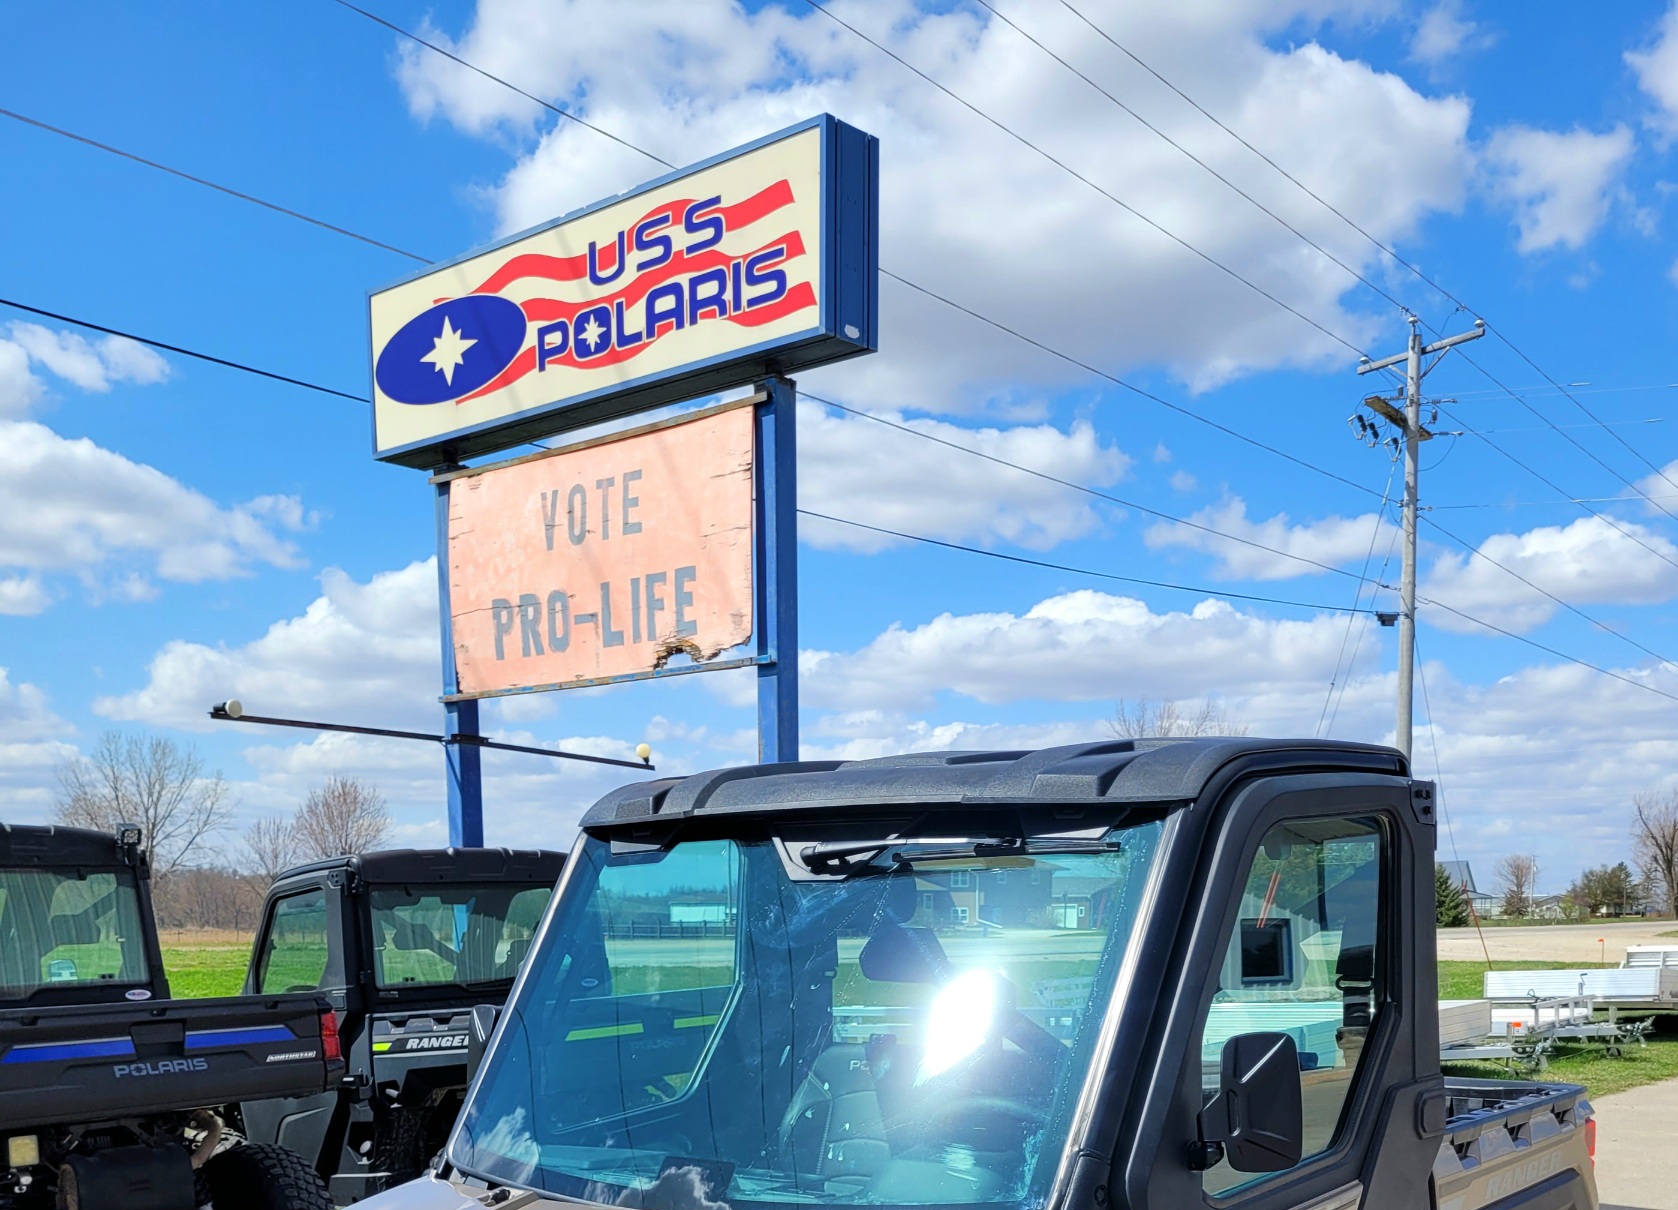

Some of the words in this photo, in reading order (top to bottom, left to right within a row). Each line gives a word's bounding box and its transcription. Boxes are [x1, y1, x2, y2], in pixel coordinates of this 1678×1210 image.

[588, 195, 723, 286] USS
[537, 247, 788, 373] POLARIS
[540, 469, 644, 551] VOTE
[491, 565, 699, 661] PRO-LIFE
[113, 1058, 209, 1078] POLARIS
[1485, 1151, 1562, 1200] RANGER
